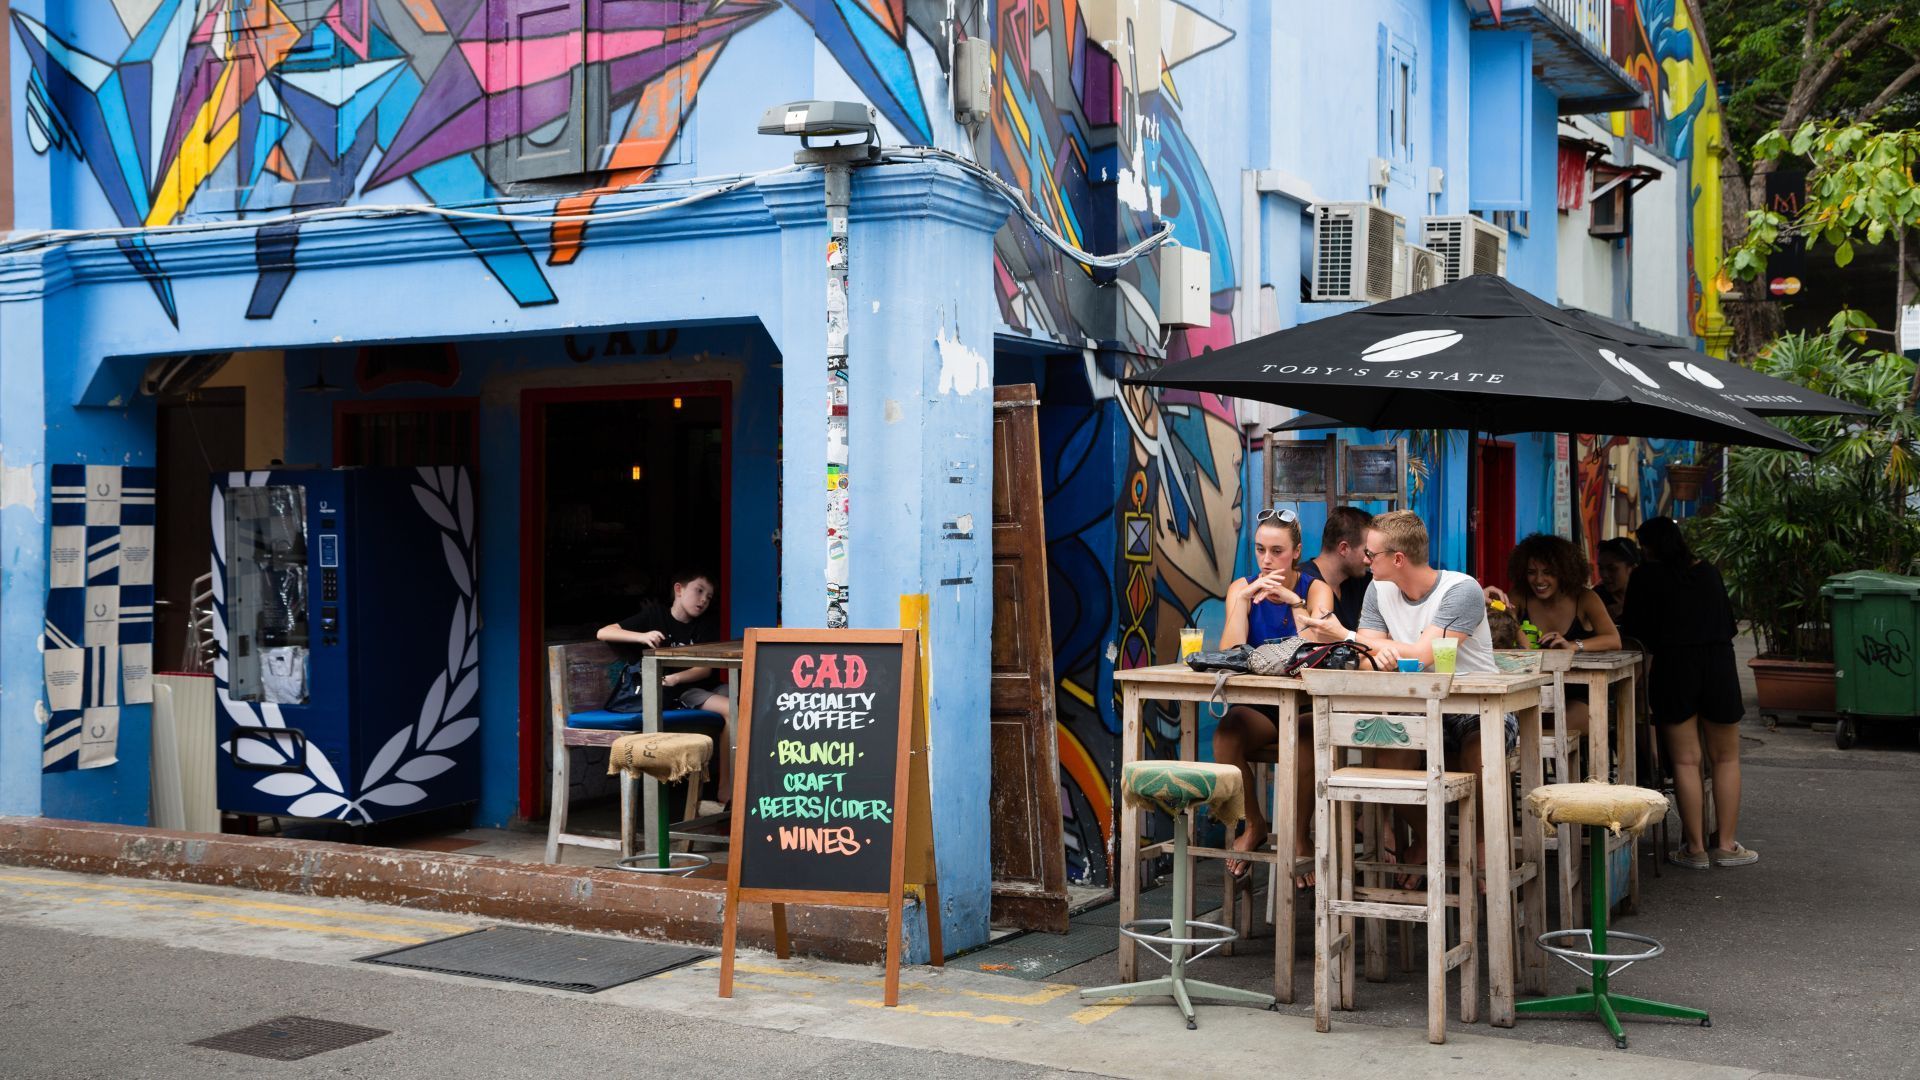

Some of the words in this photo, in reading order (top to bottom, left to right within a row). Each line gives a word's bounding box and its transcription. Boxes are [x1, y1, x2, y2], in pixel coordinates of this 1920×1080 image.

[1259, 364, 1370, 377] TOBY'S
[1384, 369, 1504, 384] ESTATE
[791, 654, 868, 689] CAD
[1289, 661, 1309, 676] Canon
[776, 692, 876, 711] SPECIALTY
[792, 710, 869, 730] COFFEE
[777, 740, 855, 766] BRUNCH
[783, 773, 847, 792] CRAFT
[779, 826, 861, 856] WINES
